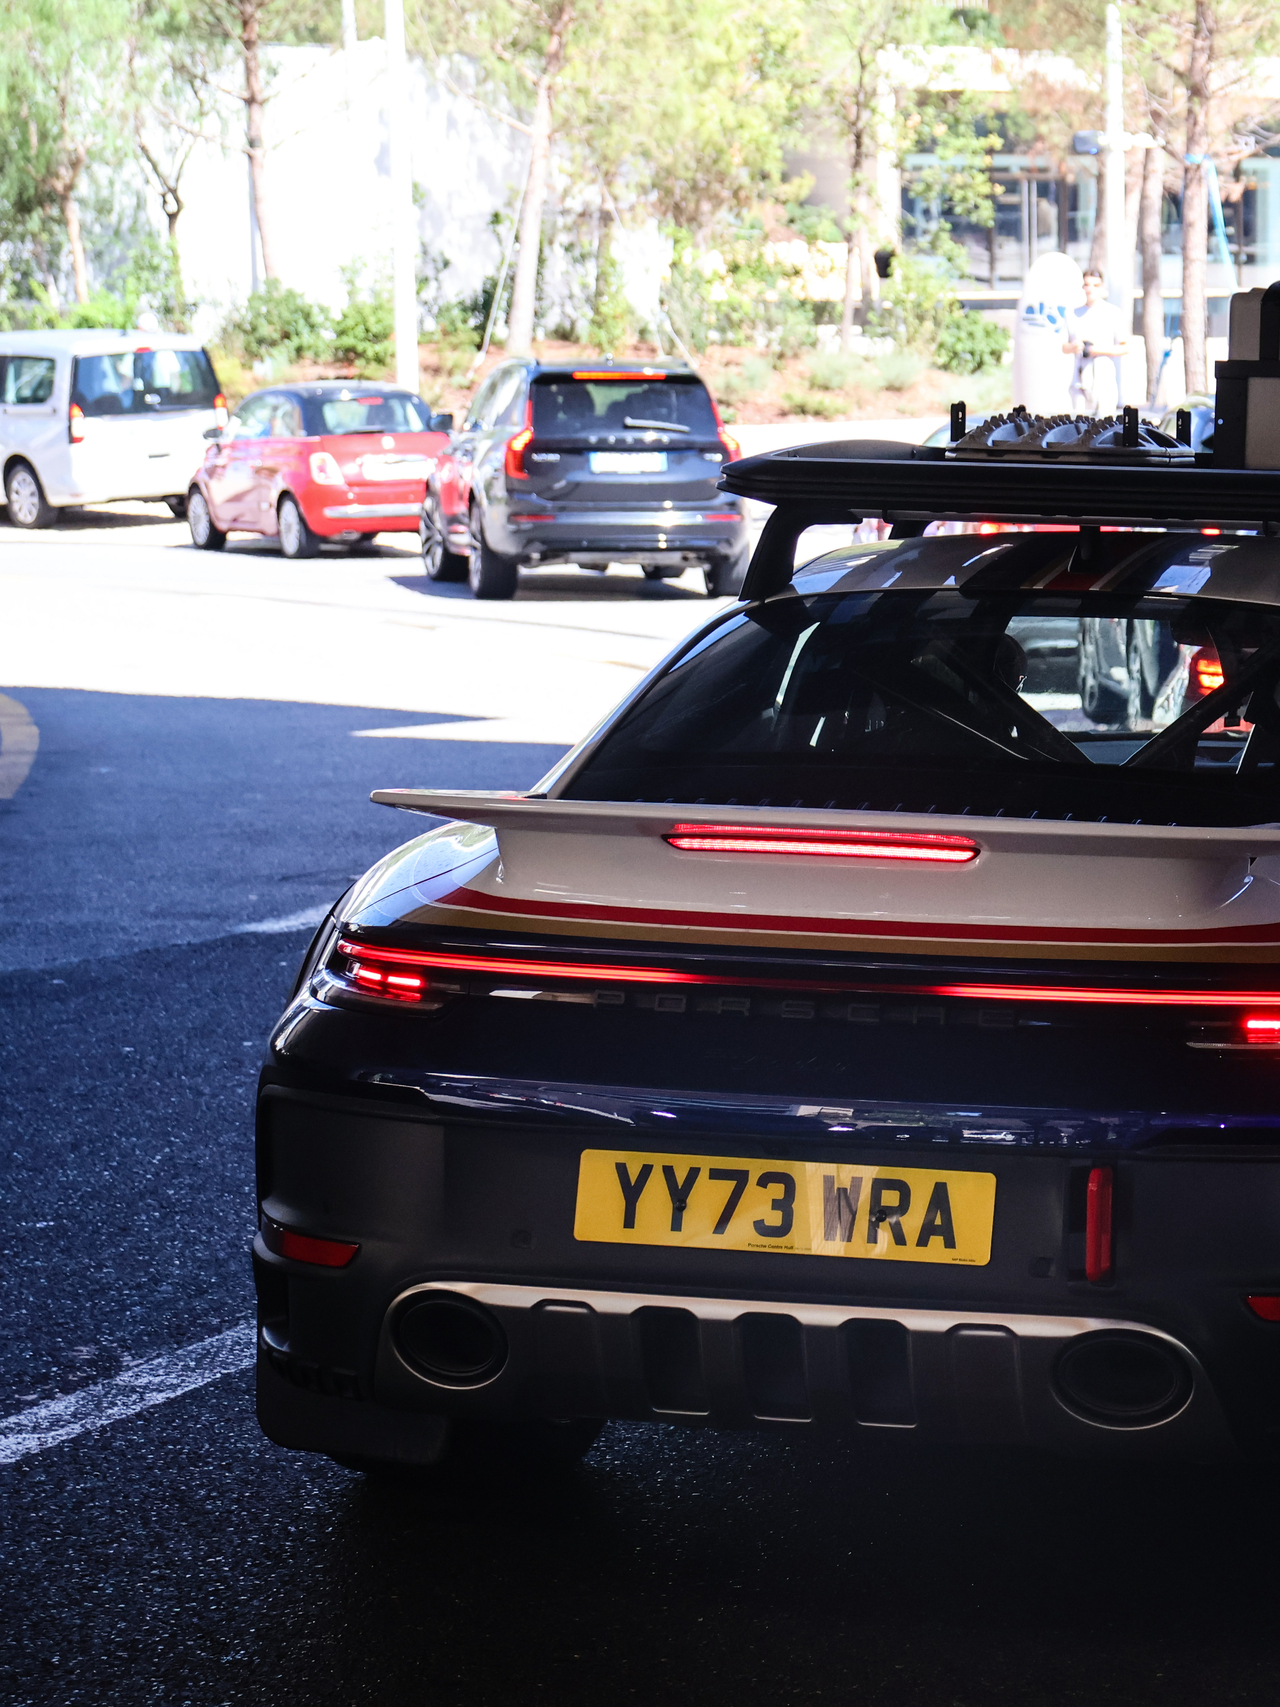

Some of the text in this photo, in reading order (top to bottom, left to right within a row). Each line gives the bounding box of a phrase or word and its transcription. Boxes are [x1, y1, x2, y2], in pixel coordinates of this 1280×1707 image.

[594, 989, 1015, 1028] PORSCHE
[615, 1161, 957, 1250] YY73 WRA
